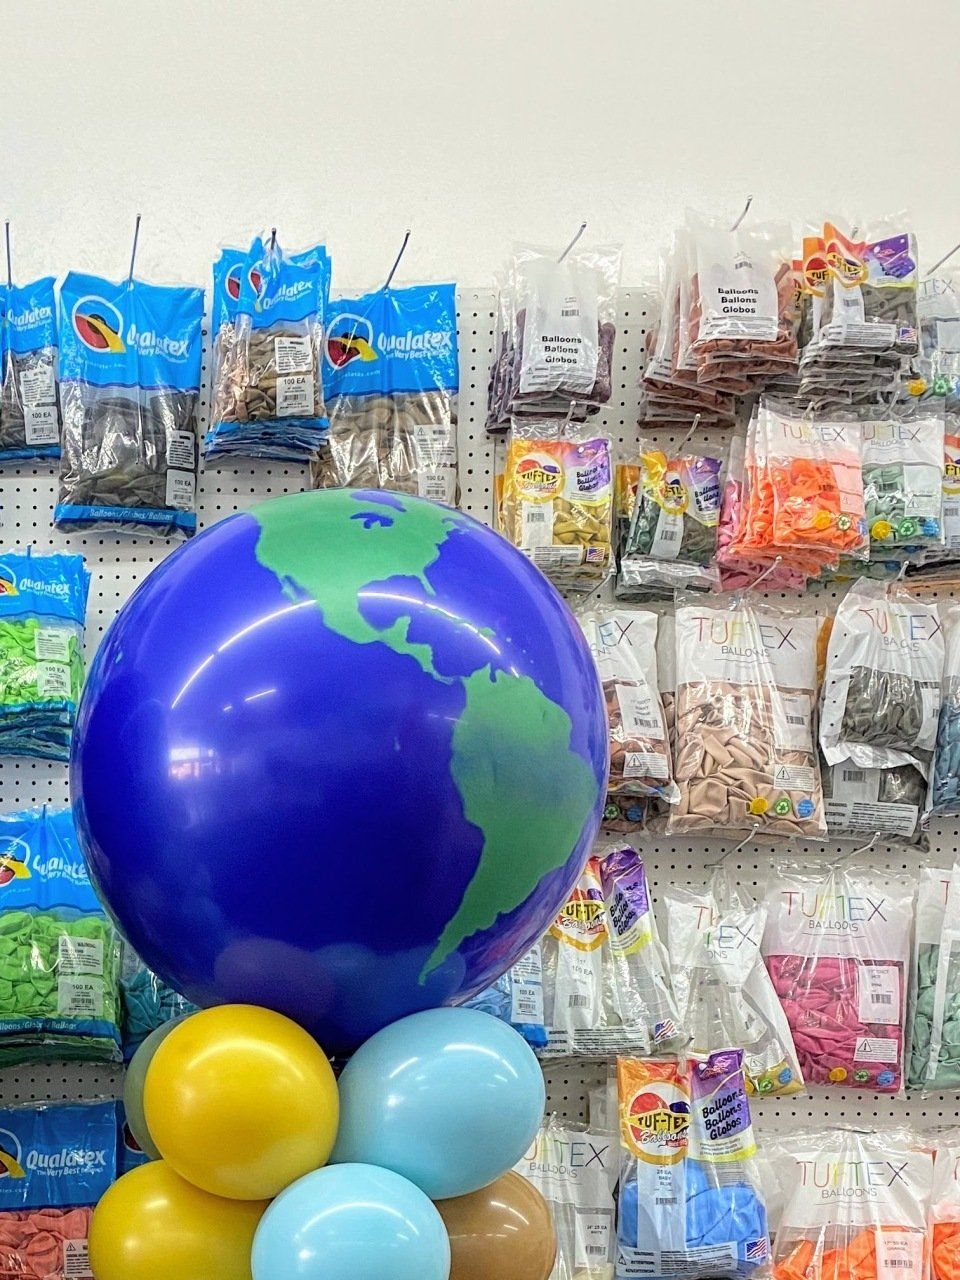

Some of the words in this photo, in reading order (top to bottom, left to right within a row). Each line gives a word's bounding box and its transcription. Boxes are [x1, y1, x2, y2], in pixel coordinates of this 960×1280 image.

[718, 287, 759, 296] Balloons
[721, 296, 757, 304] Ballons
[722, 305, 756, 314] Globos
[377, 329, 454, 353] Qualatex
[541, 335, 582, 345] Balloons
[544, 345, 578, 355] Ballons
[545, 355, 578, 365] Globos
[297, 377, 306, 385] EA
[19, 578, 70, 595] Qualatex
[701, 1088, 744, 1119] Balloons
[637, 1112, 688, 1130] TUF-TEX
[704, 1103, 743, 1131] Ballons
[709, 1116, 742, 1141] Globos
[26, 1149, 106, 1171] Qualatex
[46, 1168, 63, 1178] Very
[64, 1167, 80, 1175] Best
[821, 1187, 877, 1200] BALLOONS
